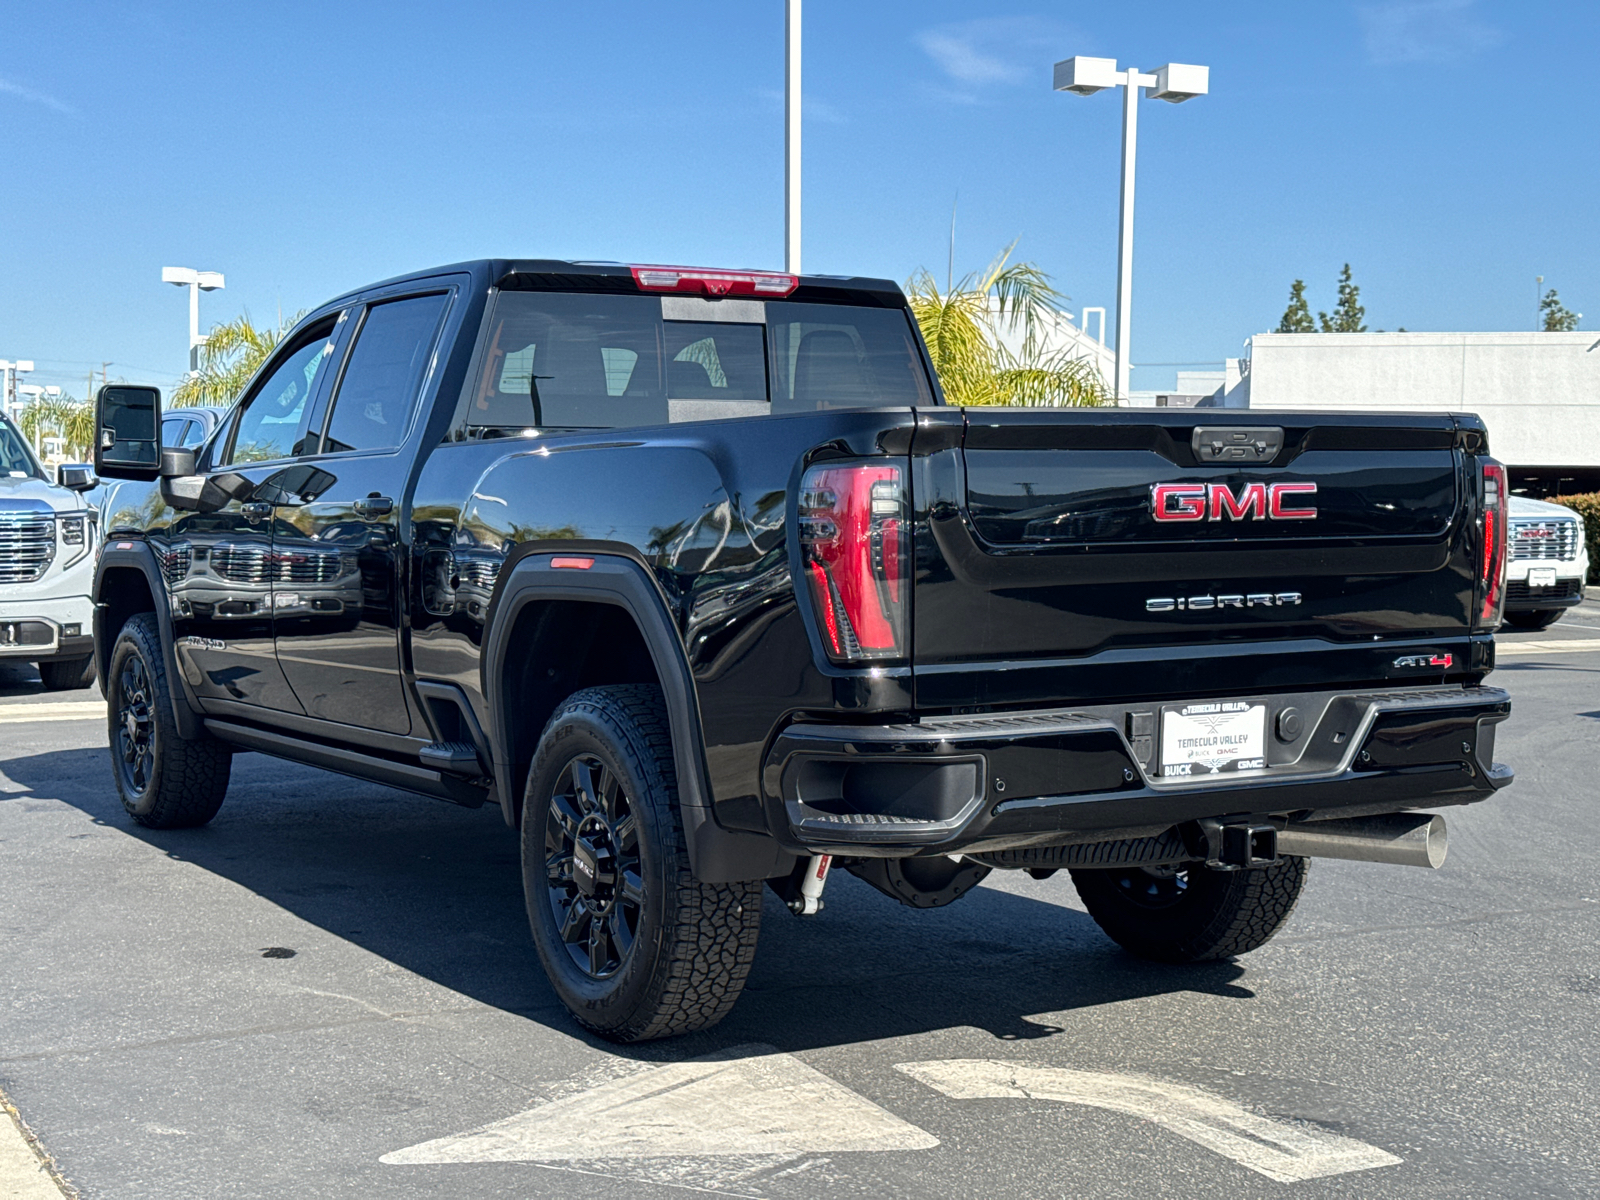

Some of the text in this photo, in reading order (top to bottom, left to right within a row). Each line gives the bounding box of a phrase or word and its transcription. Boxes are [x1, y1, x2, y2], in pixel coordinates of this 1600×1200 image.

[1151, 482, 1318, 522] GMC
[1146, 592, 1302, 611] SIERRA
[1392, 653, 1453, 669] AT4
[1187, 702, 1246, 714] TEMECULA VALLEY
[1178, 734, 1248, 748] TEMECULA VALLEY
[1165, 760, 1264, 776] BUICK GMC
